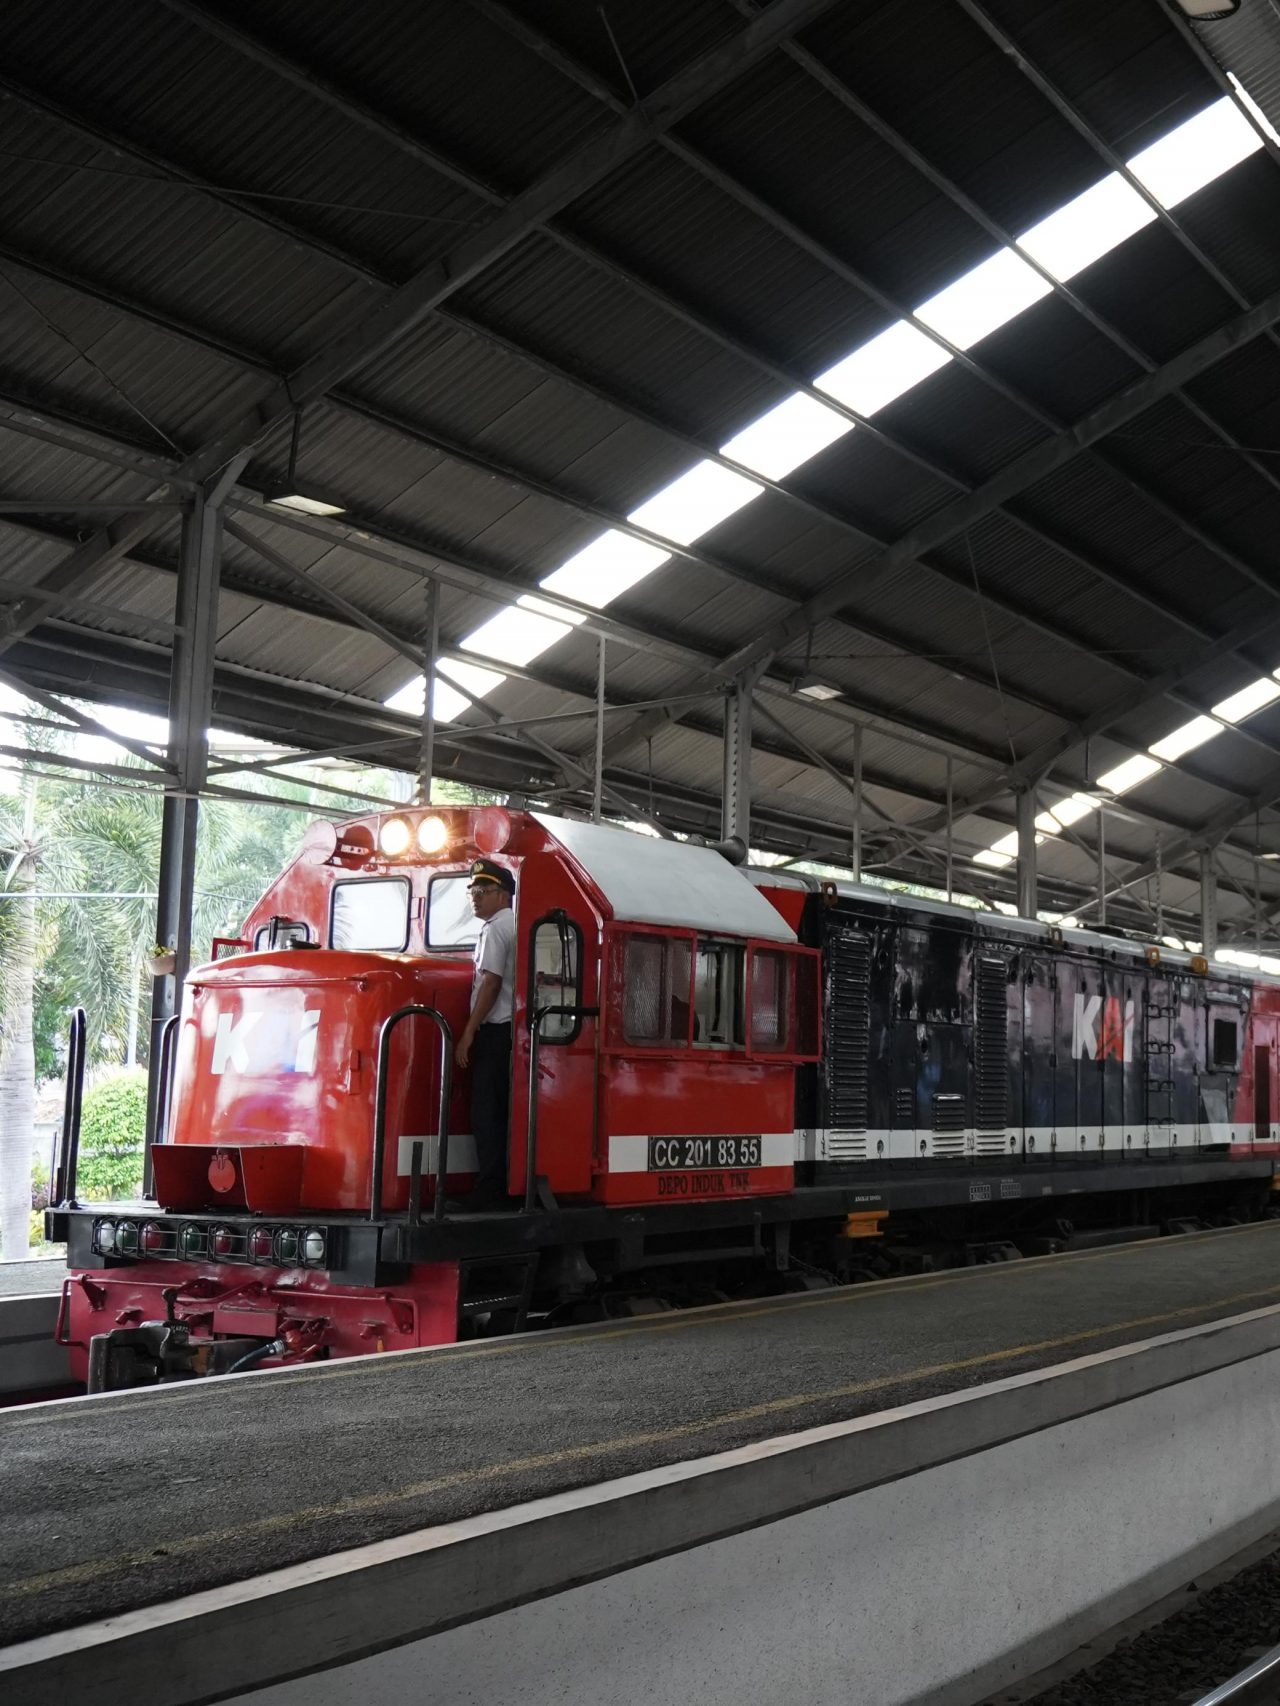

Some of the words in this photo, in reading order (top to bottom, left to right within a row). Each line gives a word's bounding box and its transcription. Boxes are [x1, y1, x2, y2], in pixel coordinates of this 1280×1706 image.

[1072, 993, 1135, 1063] KAI
[655, 1139, 680, 1167] CC
[685, 1139, 712, 1166] 201
[718, 1139, 736, 1165] 83
[740, 1138, 758, 1164] 55
[658, 1175, 689, 1195] DEPO
[691, 1174, 725, 1193] INDUK
